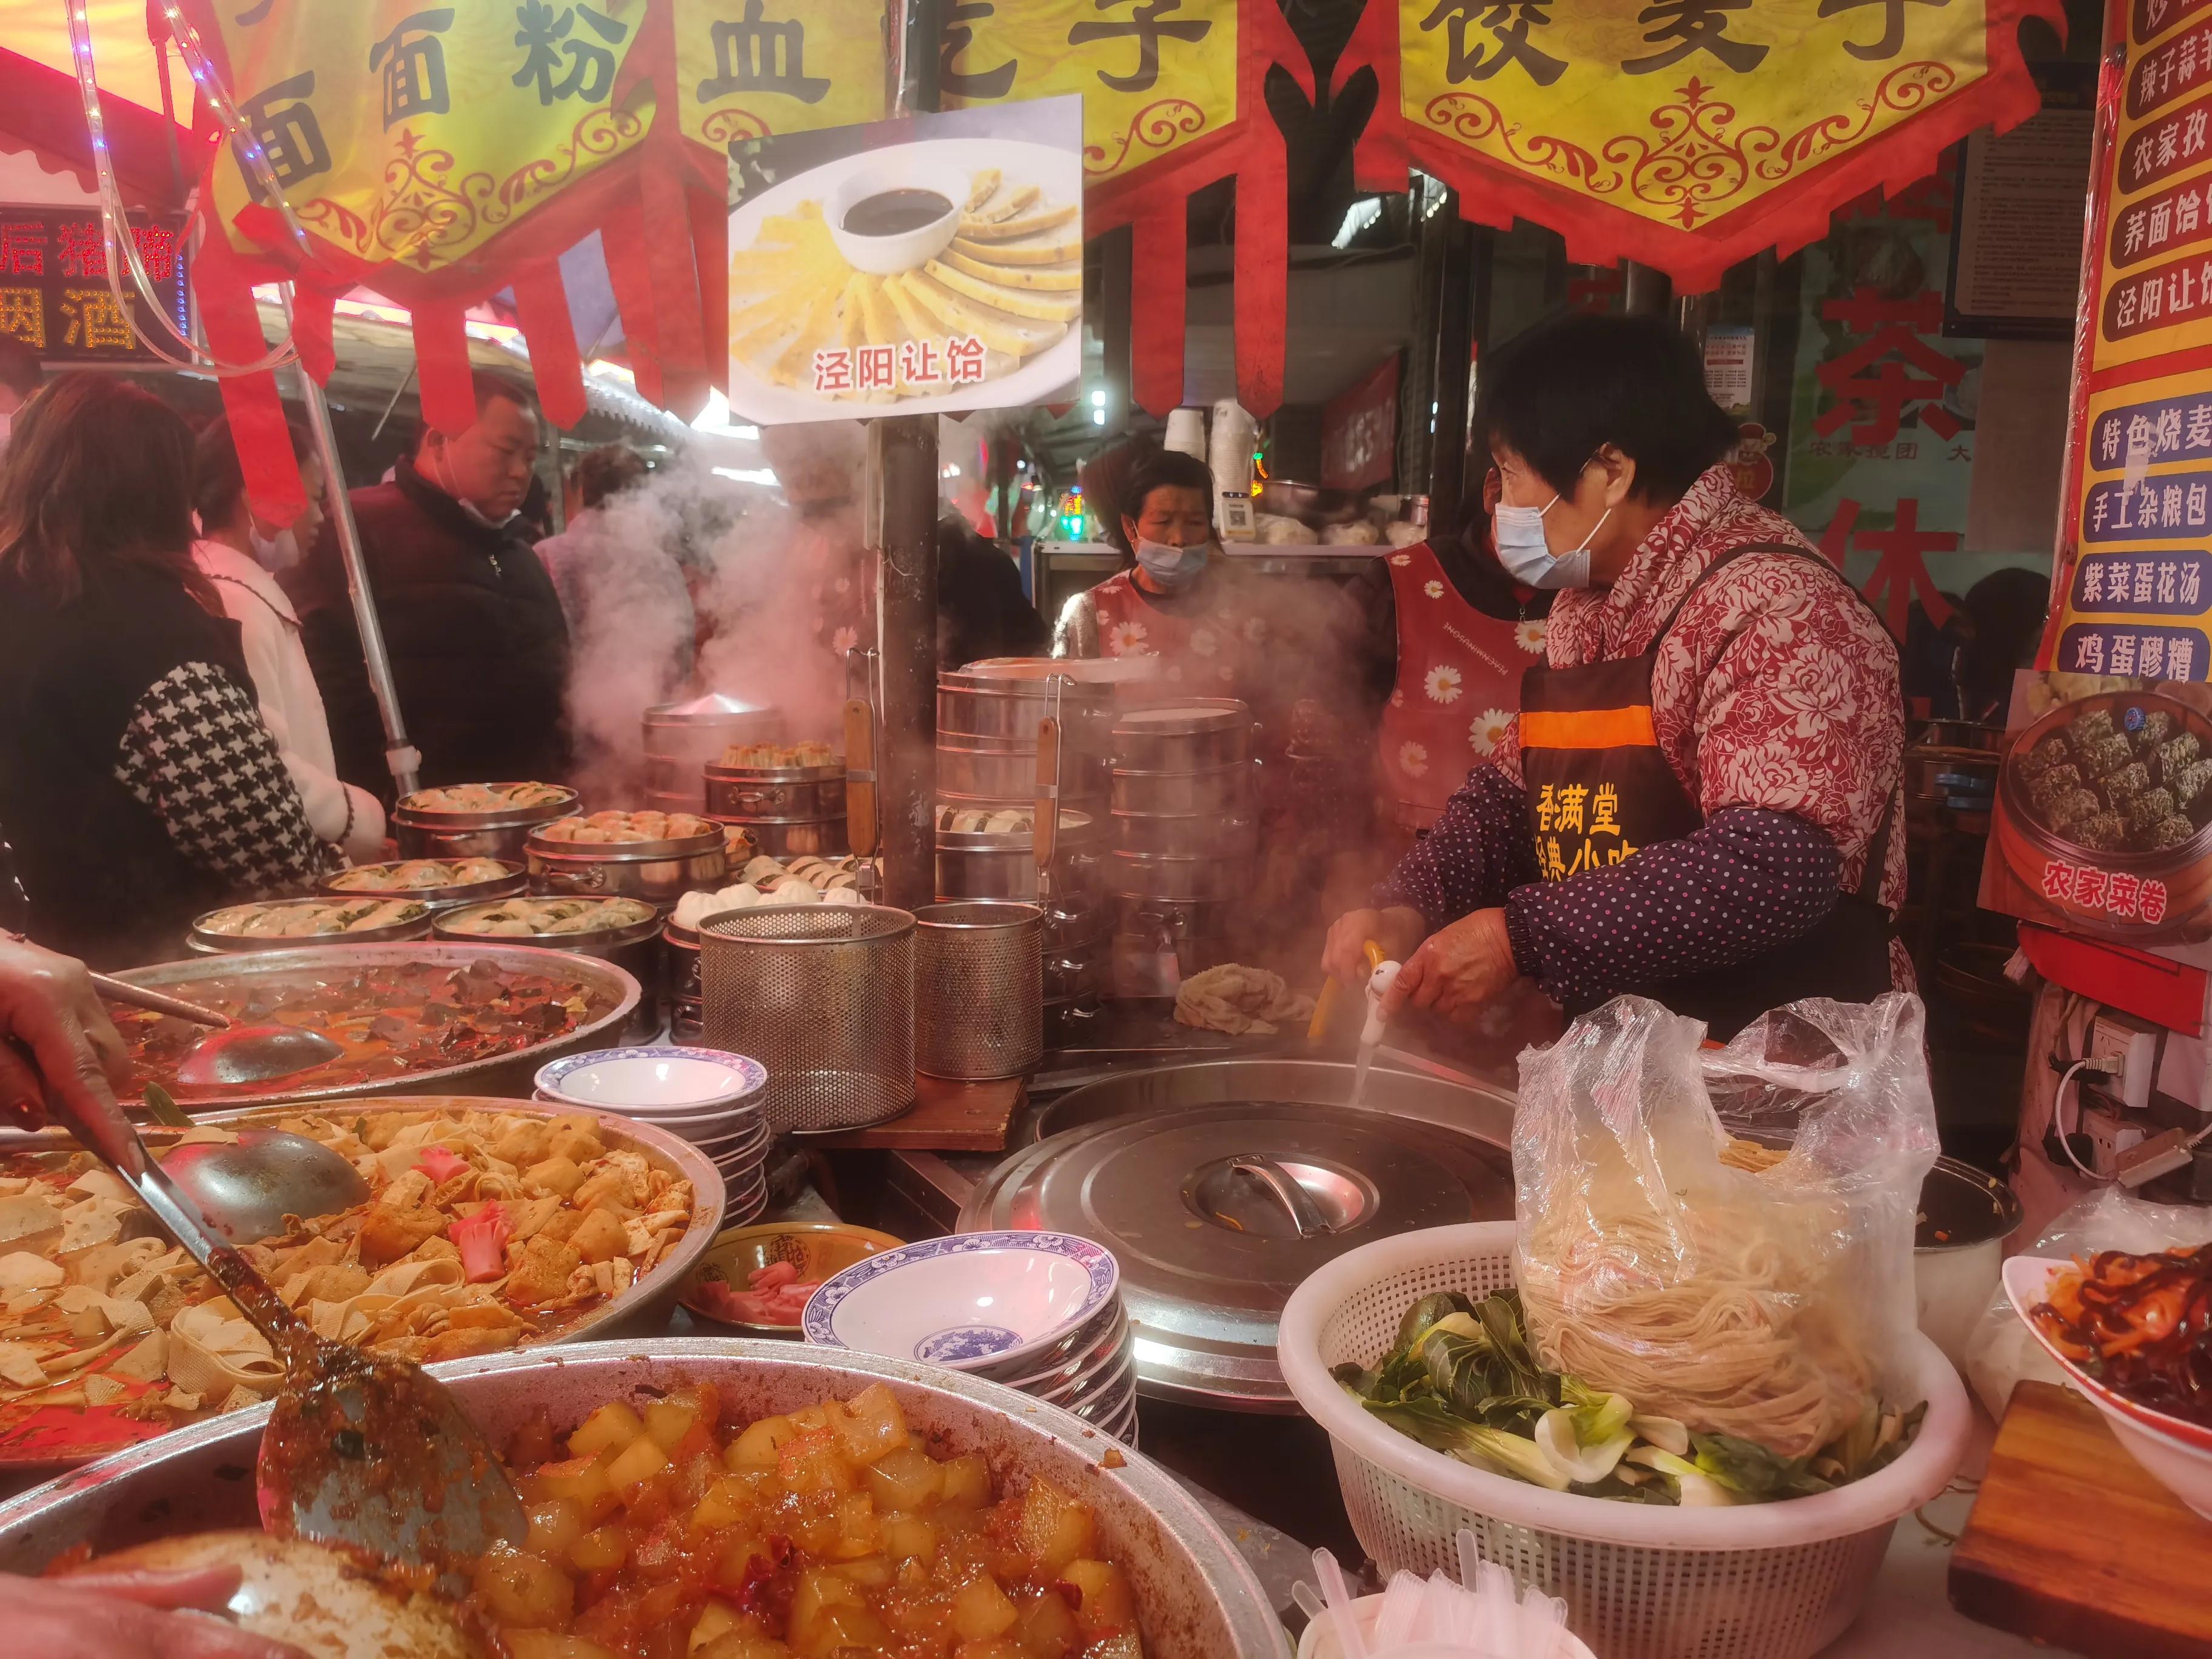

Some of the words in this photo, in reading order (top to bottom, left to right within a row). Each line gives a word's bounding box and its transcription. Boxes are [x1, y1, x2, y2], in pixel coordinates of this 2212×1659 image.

[369, 8, 455, 134] 面
[512, 0, 628, 106] 粉
[697, 0, 831, 104] 血
[1068, 0, 1212, 92] 子
[2133, 109, 2208, 180] 农家孜
[2124, 183, 2212, 256] 荞面饸
[814, 337, 985, 392] 泾阳让饸
[2102, 404, 2212, 461] 特色烧麦
[2093, 483, 2207, 532] 手工杂粮包
[2082, 561, 2200, 605] 紫菜蛋花汤
[2076, 633, 2194, 684] 鸡蛋醪糟
[2043, 860, 2167, 925] 农家菜卷
